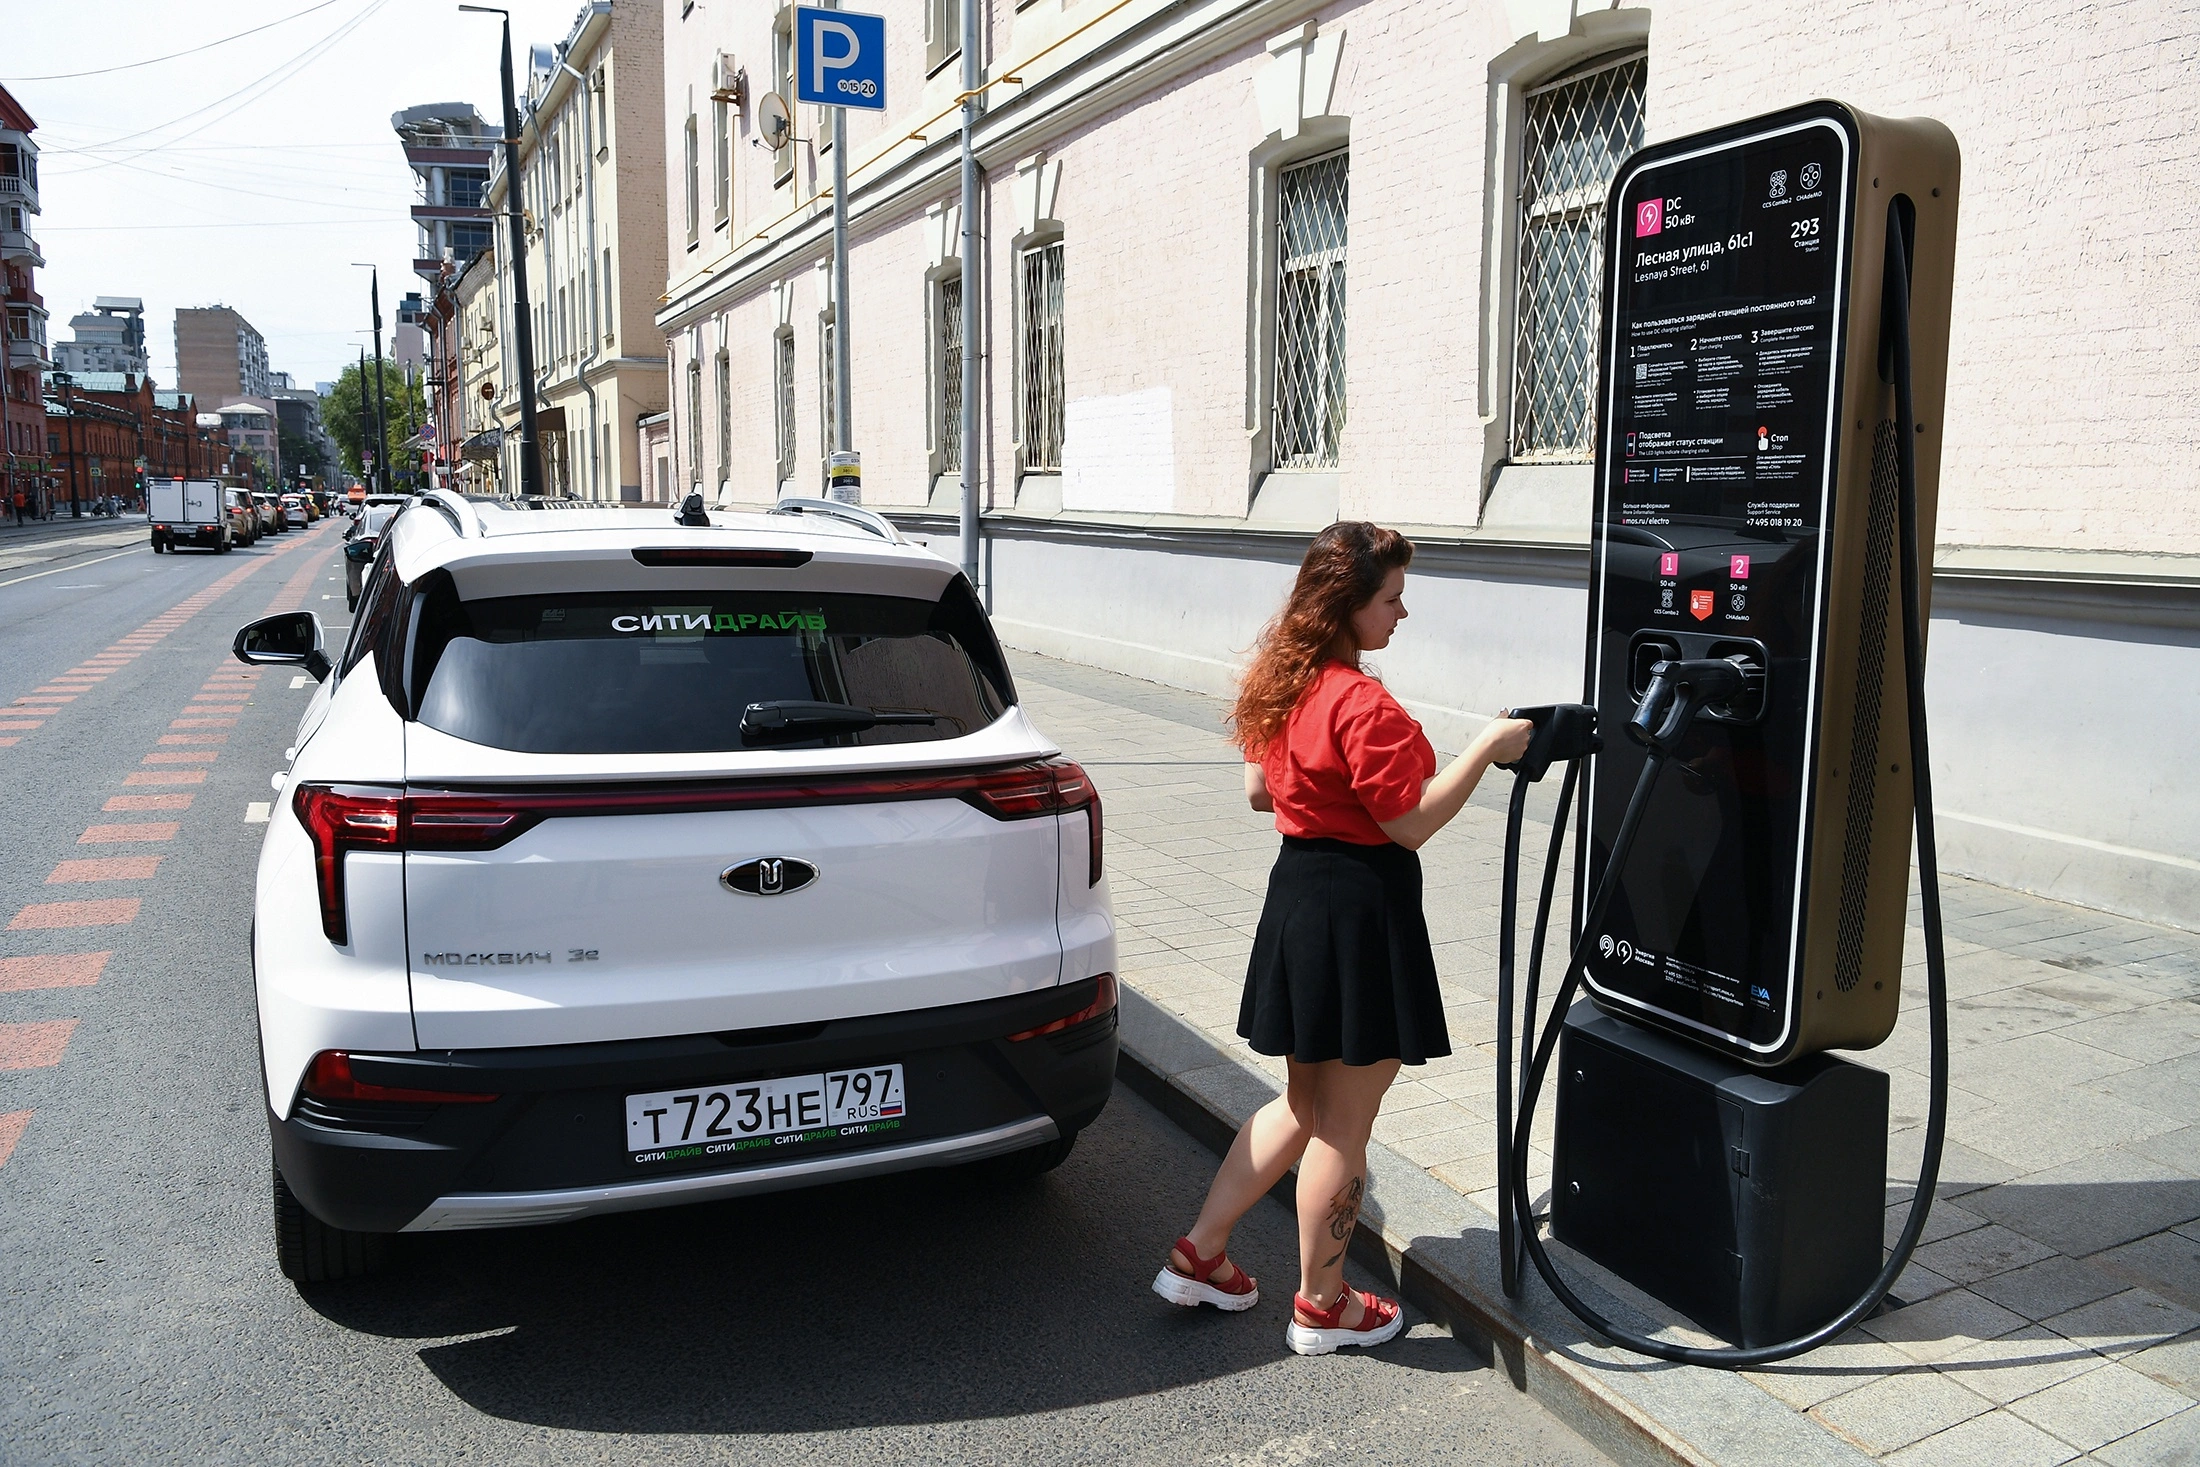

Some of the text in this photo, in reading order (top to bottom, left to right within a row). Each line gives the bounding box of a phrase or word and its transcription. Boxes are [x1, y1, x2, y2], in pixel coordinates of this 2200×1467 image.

[813, 19, 860, 93] P
[850, 83, 858, 92] 15
[862, 83, 875, 94] 20
[1666, 197, 1682, 212] DC
[1665, 214, 1695, 229] 50 кВт
[1790, 218, 1820, 239] 293
[1636, 231, 1753, 268] Лесная улица, 61с1
[1794, 238, 1820, 249] Станция
[1635, 260, 1710, 283] Lesnaya Street, 61
[1631, 296, 1816, 329] Как пользоваться зарядной станцией постоянного тока?
[1661, 326, 1679, 335] charging
[1760, 324, 1814, 337] Завершите сессию
[1699, 333, 1742, 344] Начните сессию
[1751, 331, 1759, 344] 3
[1637, 342, 1673, 352] Подключитесь
[1690, 339, 1698, 351] 2
[1630, 347, 1636, 358] 1
[1639, 431, 1672, 439] Подсветка
[1771, 434, 1788, 443] Стоп
[1638, 437, 1723, 450] отображает статус станции
[1641, 502, 1670, 510] информации
[1747, 501, 1800, 510] Служба поддержки
[1626, 517, 1670, 526] mos.ru/electro
[1746, 518, 1803, 527] +7 495 018 19 20
[1666, 557, 1673, 571] 1
[1736, 559, 1744, 574] 2
[1730, 583, 1738, 591] 50
[611, 611, 827, 632] СИТИДРАЙВ
[423, 950, 552, 966] МОСКВИЧ
[1634, 955, 1654, 966] Москвы
[1635, 948, 1655, 960] Энергия
[829, 1069, 893, 1110] 797
[847, 1105, 879, 1120] RUS
[635, 1120, 900, 1164] СИТИДРАЙВ СИТИДРАЙВ СИТИДРАЙВ СИТИДРАЙВ
